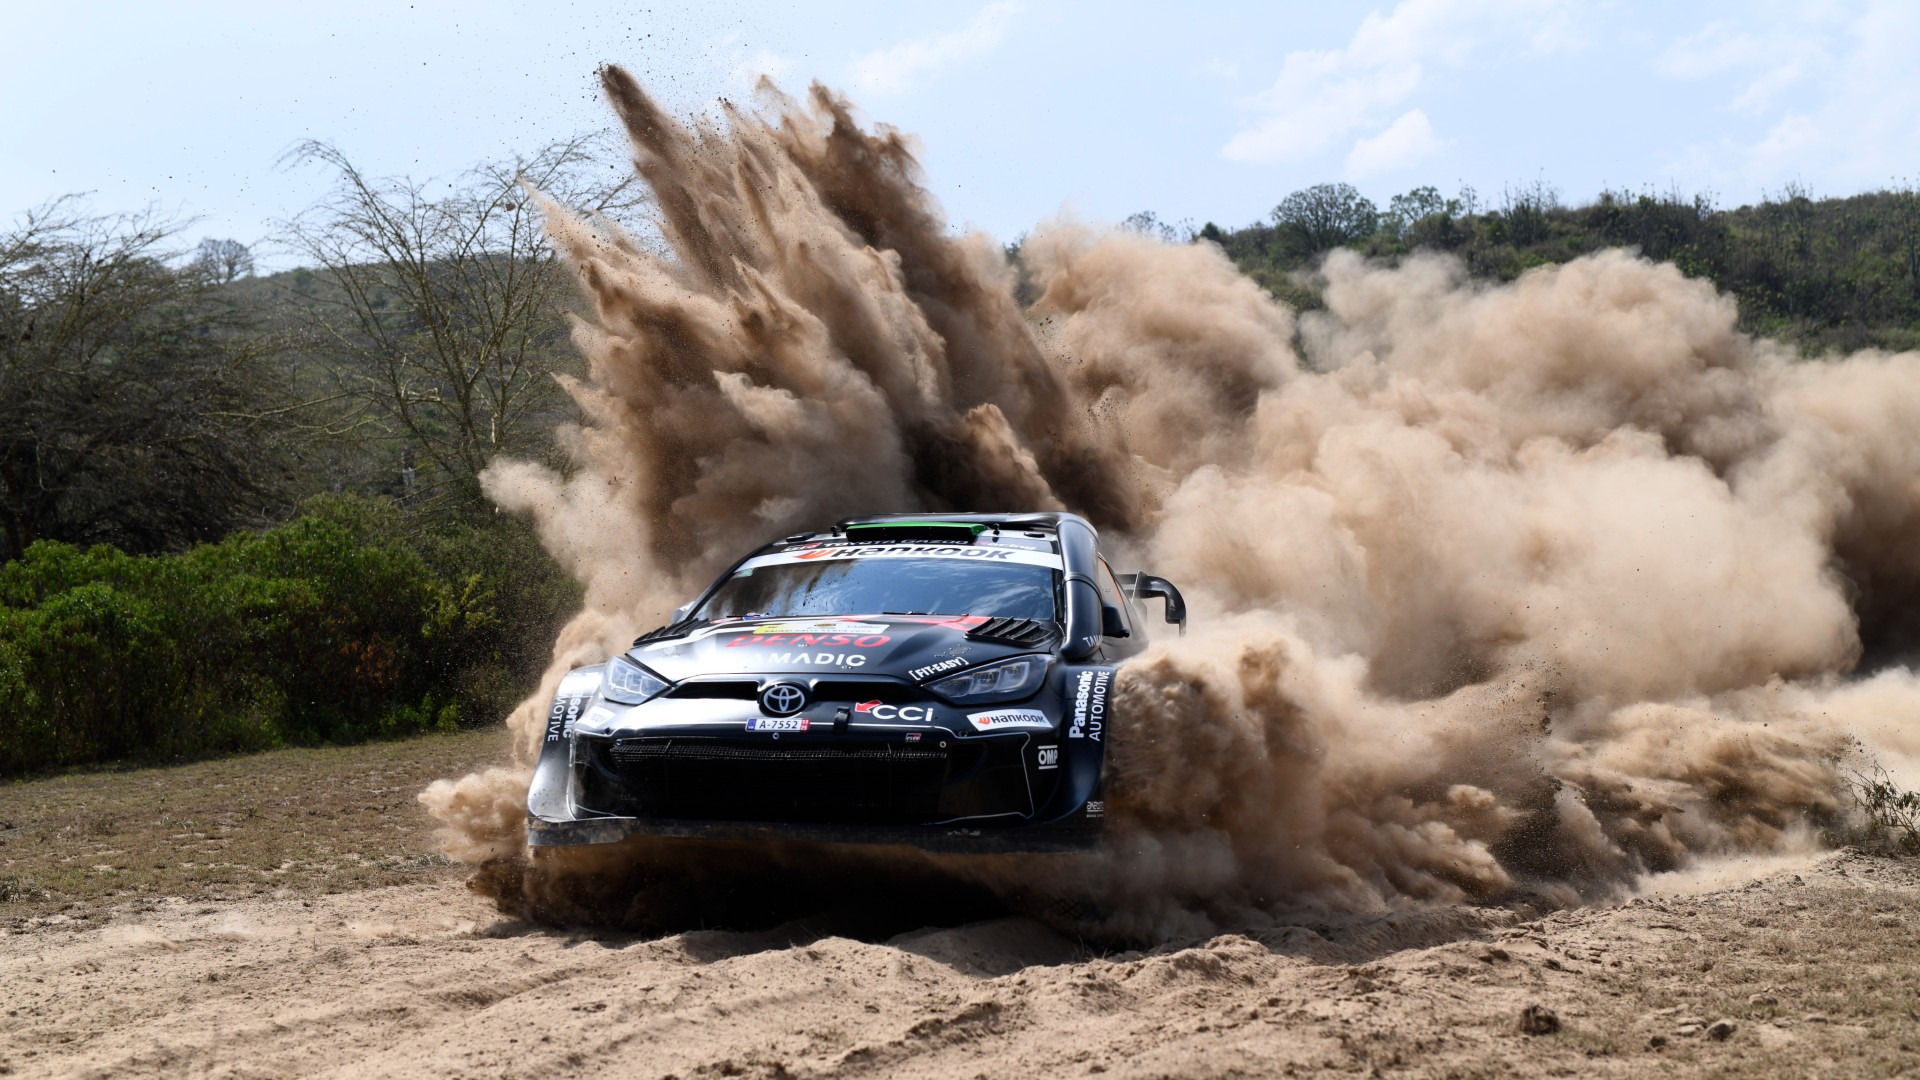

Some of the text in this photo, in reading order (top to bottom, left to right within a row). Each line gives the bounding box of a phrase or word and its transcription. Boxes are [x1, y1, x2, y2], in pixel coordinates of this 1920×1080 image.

[824, 540, 896, 548] TOYOTA
[725, 634, 891, 648] DENSO
[746, 653, 867, 667] AMADIC
[1069, 671, 1094, 738] Panasonic
[1089, 671, 1110, 742] AUTOMOTIVE
[759, 720, 798, 729] A-7552
[1038, 749, 1058, 765] OMP
